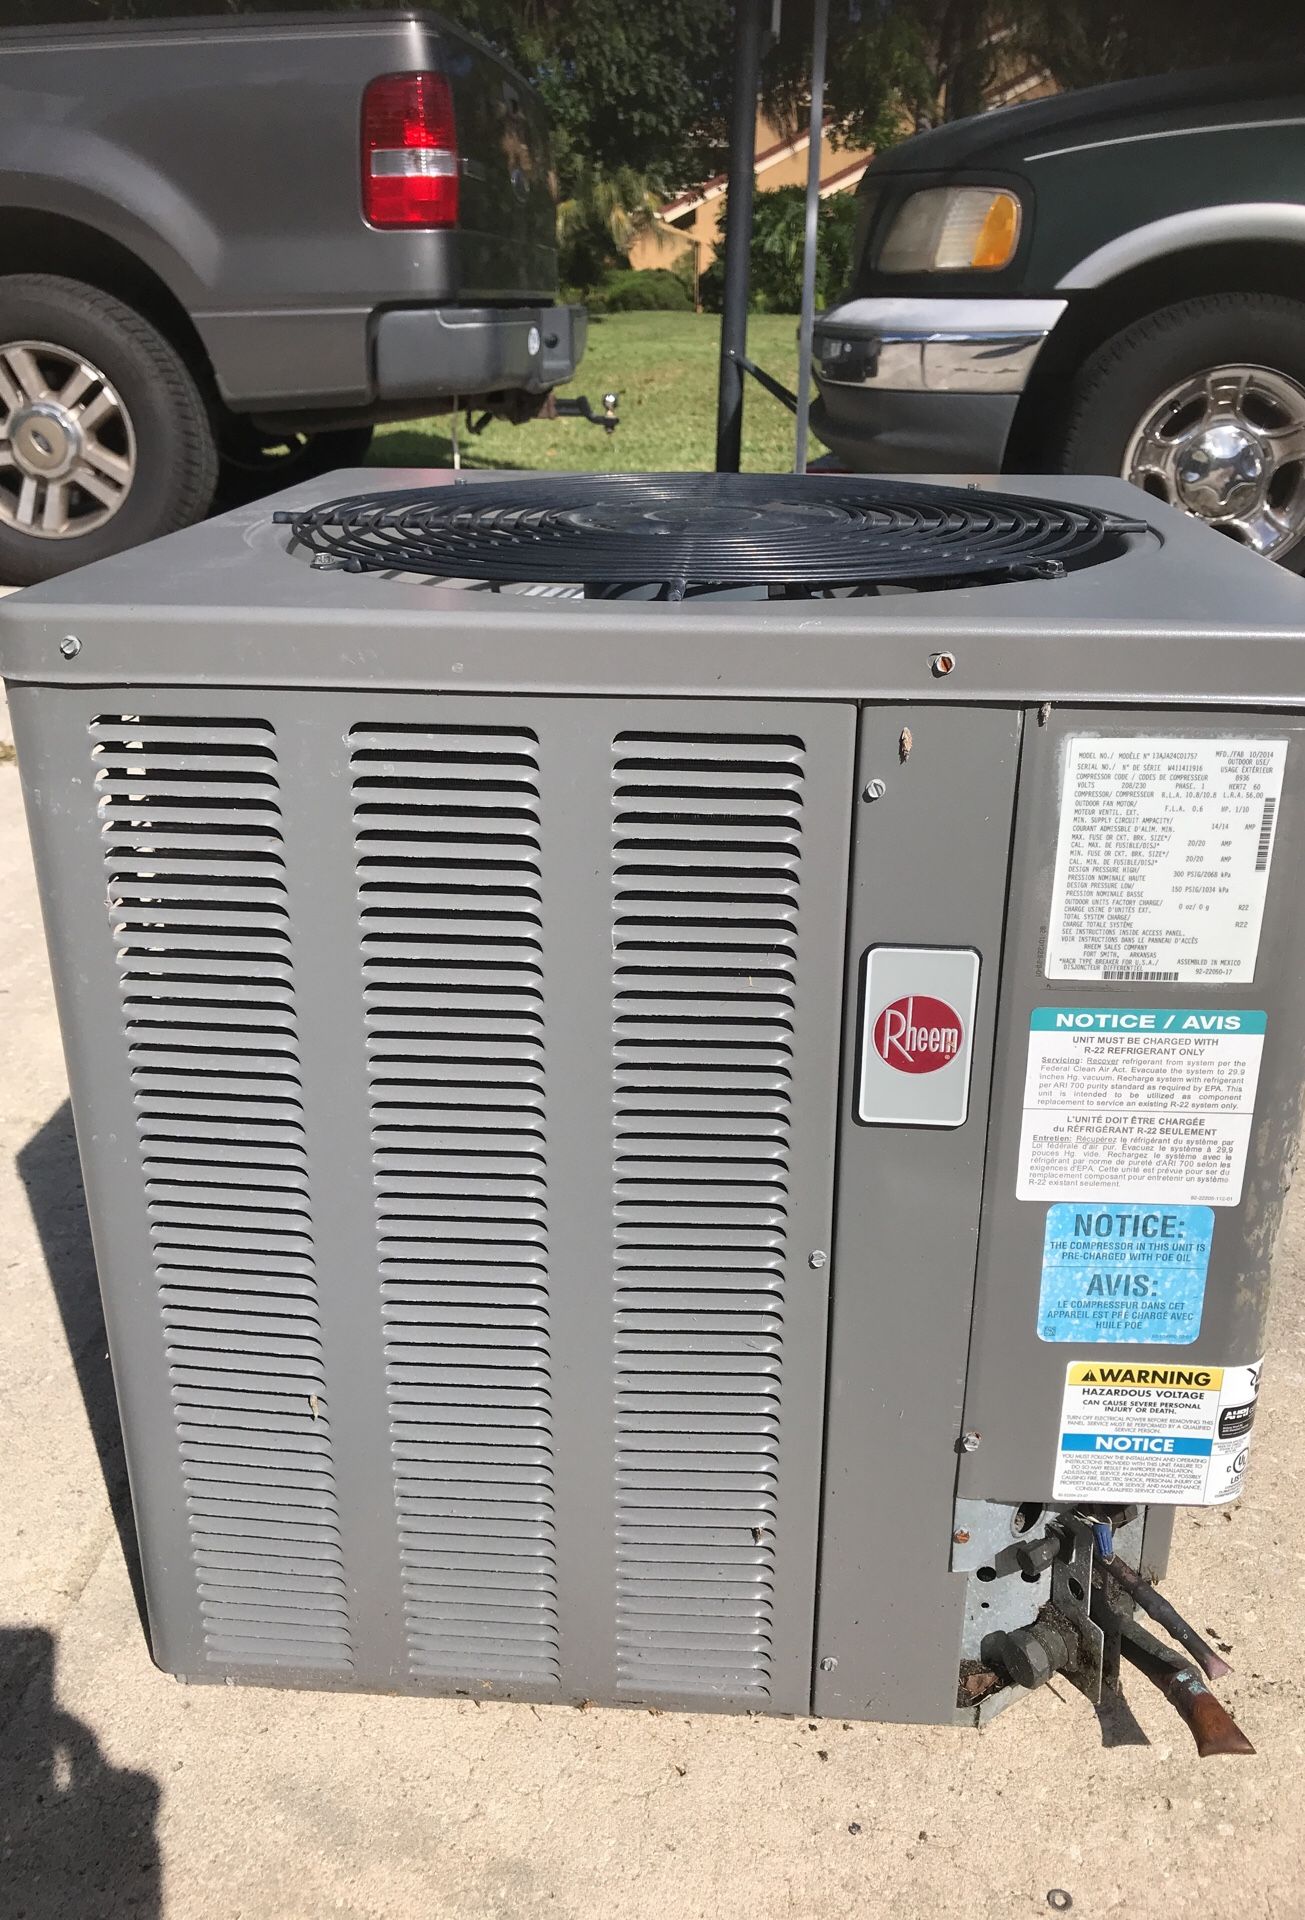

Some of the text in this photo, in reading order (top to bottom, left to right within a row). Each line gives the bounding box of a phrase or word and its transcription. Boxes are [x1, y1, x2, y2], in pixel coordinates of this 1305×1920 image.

[1056, 1013, 1241, 1030] NOTICE / AVIS
[883, 996, 958, 1062] Rheem
[1073, 1036, 1095, 1044] UNIT
[1194, 1038, 1219, 1046] WITH
[1108, 1047, 1176, 1055] REFRIGERANT
[1041, 1056, 1083, 1064] Servicing:
[1122, 1058, 1163, 1066] refrigerant
[1067, 1074, 1080, 1082] Hg.
[1117, 1075, 1154, 1083] Recharge
[1067, 1115, 1103, 1123] L'UNITÉ
[1131, 1116, 1155, 1124] ÊTRE
[1159, 1117, 1205, 1126] CHARGÉE
[1067, 1125, 1135, 1134] RÉFRIGÉRANT
[1159, 1128, 1217, 1136] SEULEMENT
[1074, 1213, 1185, 1238] NOTICE:
[1070, 1242, 1133, 1250] COMPRESSOR
[1136, 1242, 1146, 1250] IN
[1149, 1243, 1170, 1251] THIS
[1172, 1243, 1194, 1251] UNIT
[1196, 1244, 1205, 1252] IS
[1062, 1252, 1126, 1260] PRE-CHARGED
[1129, 1253, 1153, 1261] WITH
[1176, 1254, 1191, 1262] OIL
[1086, 1274, 1158, 1297] AVIS:
[1071, 1301, 1138, 1309] COMPRESSEUR
[1168, 1302, 1185, 1310] CET
[1047, 1310, 1089, 1318] APPAREIL
[1093, 1311, 1110, 1319] EST
[1170, 1312, 1194, 1320] AVEC
[1096, 1321, 1143, 1329] HUILE POE
[1100, 1369, 1211, 1386] WARNING
[1082, 1388, 1205, 1400] HAZARDOUS VOLTAGE
[1096, 1436, 1175, 1452] NOTICE
